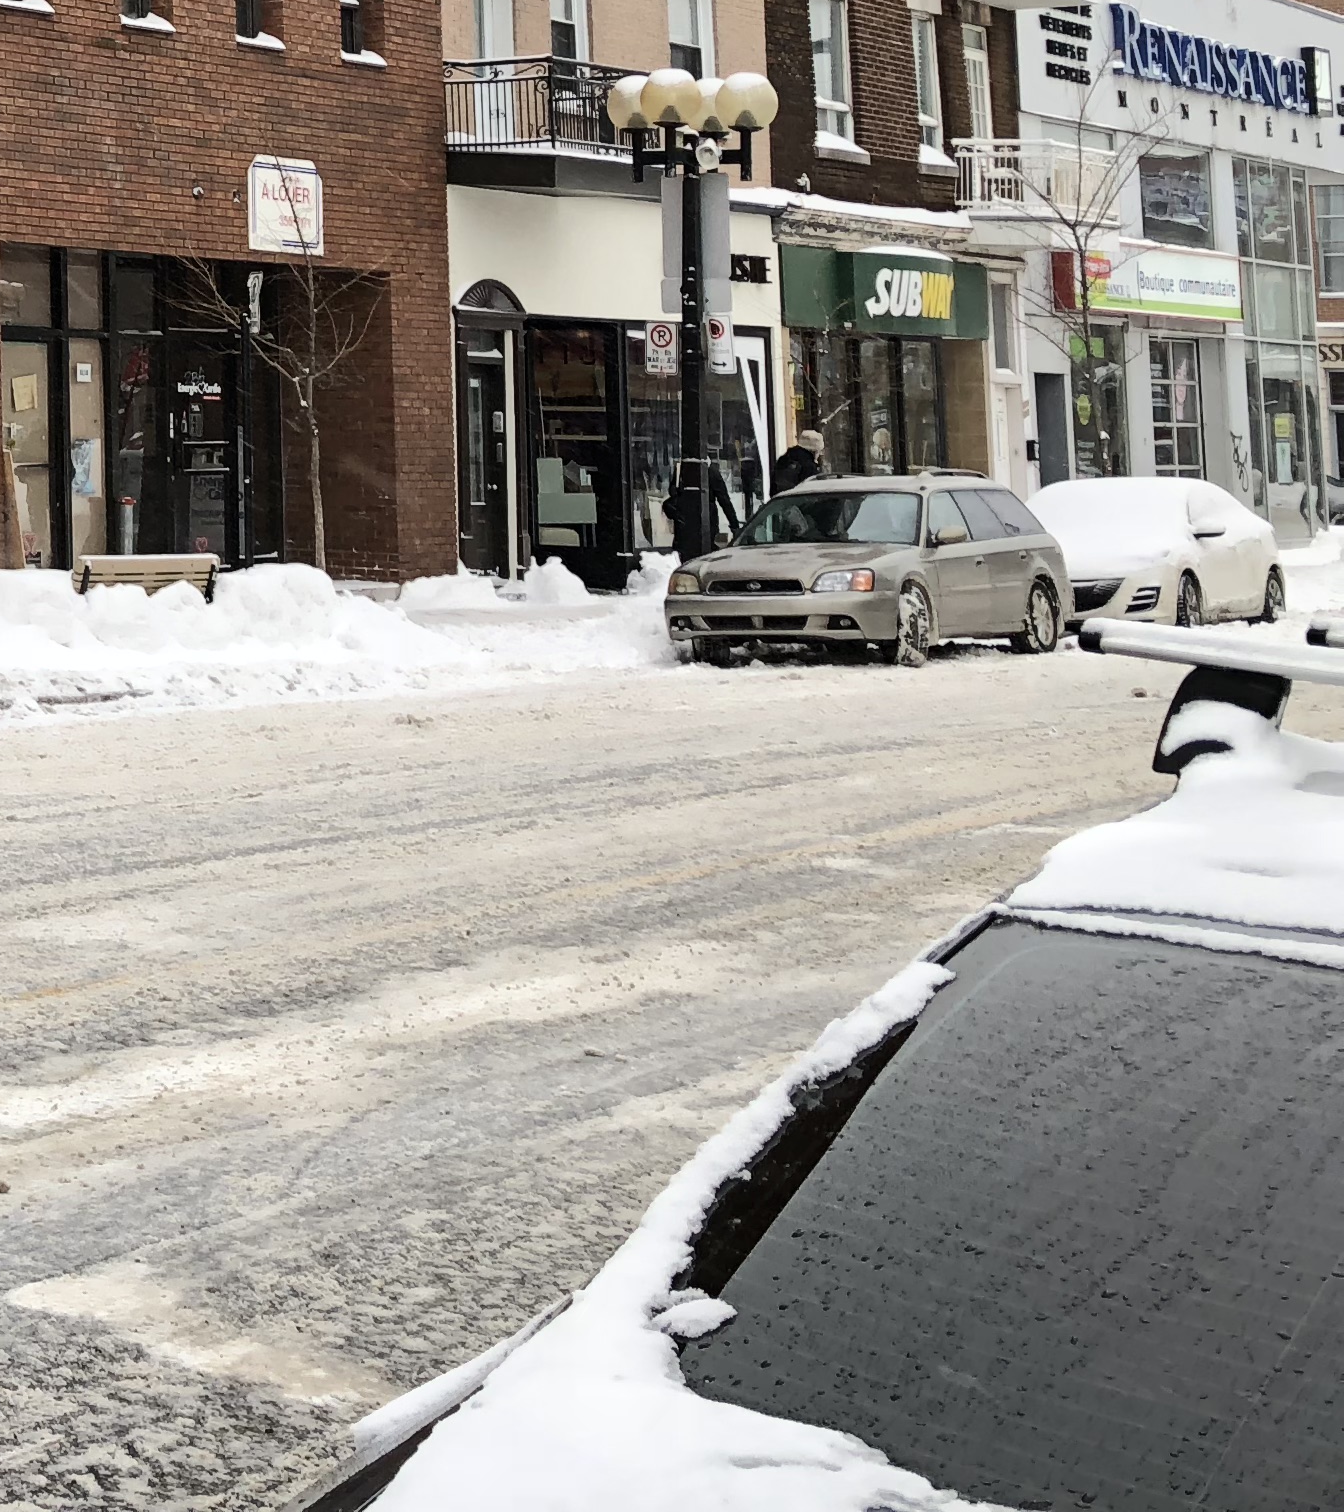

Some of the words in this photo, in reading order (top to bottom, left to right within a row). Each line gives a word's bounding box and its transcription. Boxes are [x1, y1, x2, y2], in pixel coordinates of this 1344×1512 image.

[1109, 3, 1310, 114] RENAISSANCE
[1118, 90, 1323, 148] MONTRÉAL
[865, 267, 955, 319] SUBWAY
[1139, 271, 1175, 295] Boutique
[1179, 278, 1237, 298] communautaire
